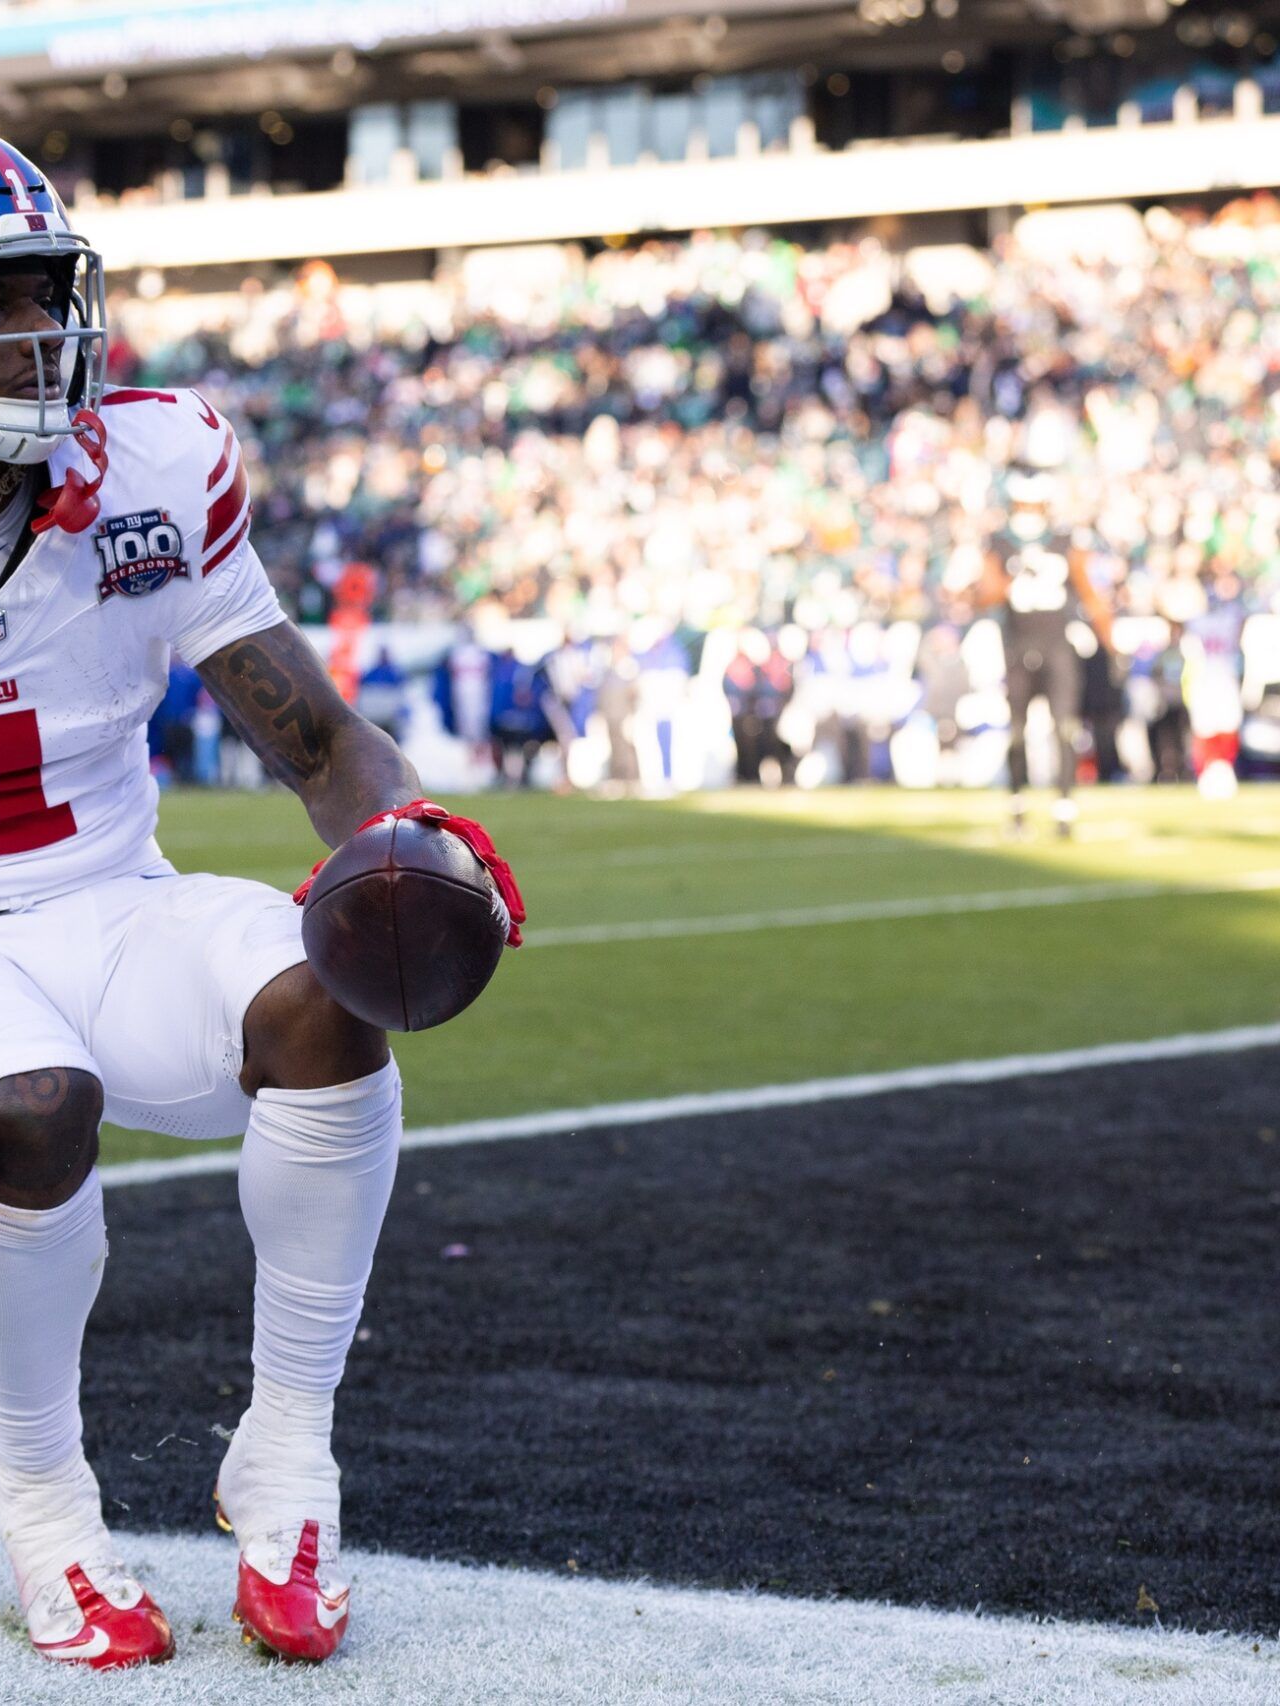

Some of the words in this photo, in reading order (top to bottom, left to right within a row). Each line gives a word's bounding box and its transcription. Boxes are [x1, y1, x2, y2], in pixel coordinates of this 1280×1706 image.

[5, 168, 34, 211] 1
[97, 525, 181, 574] 100
[110, 560, 175, 582] SEASONS
